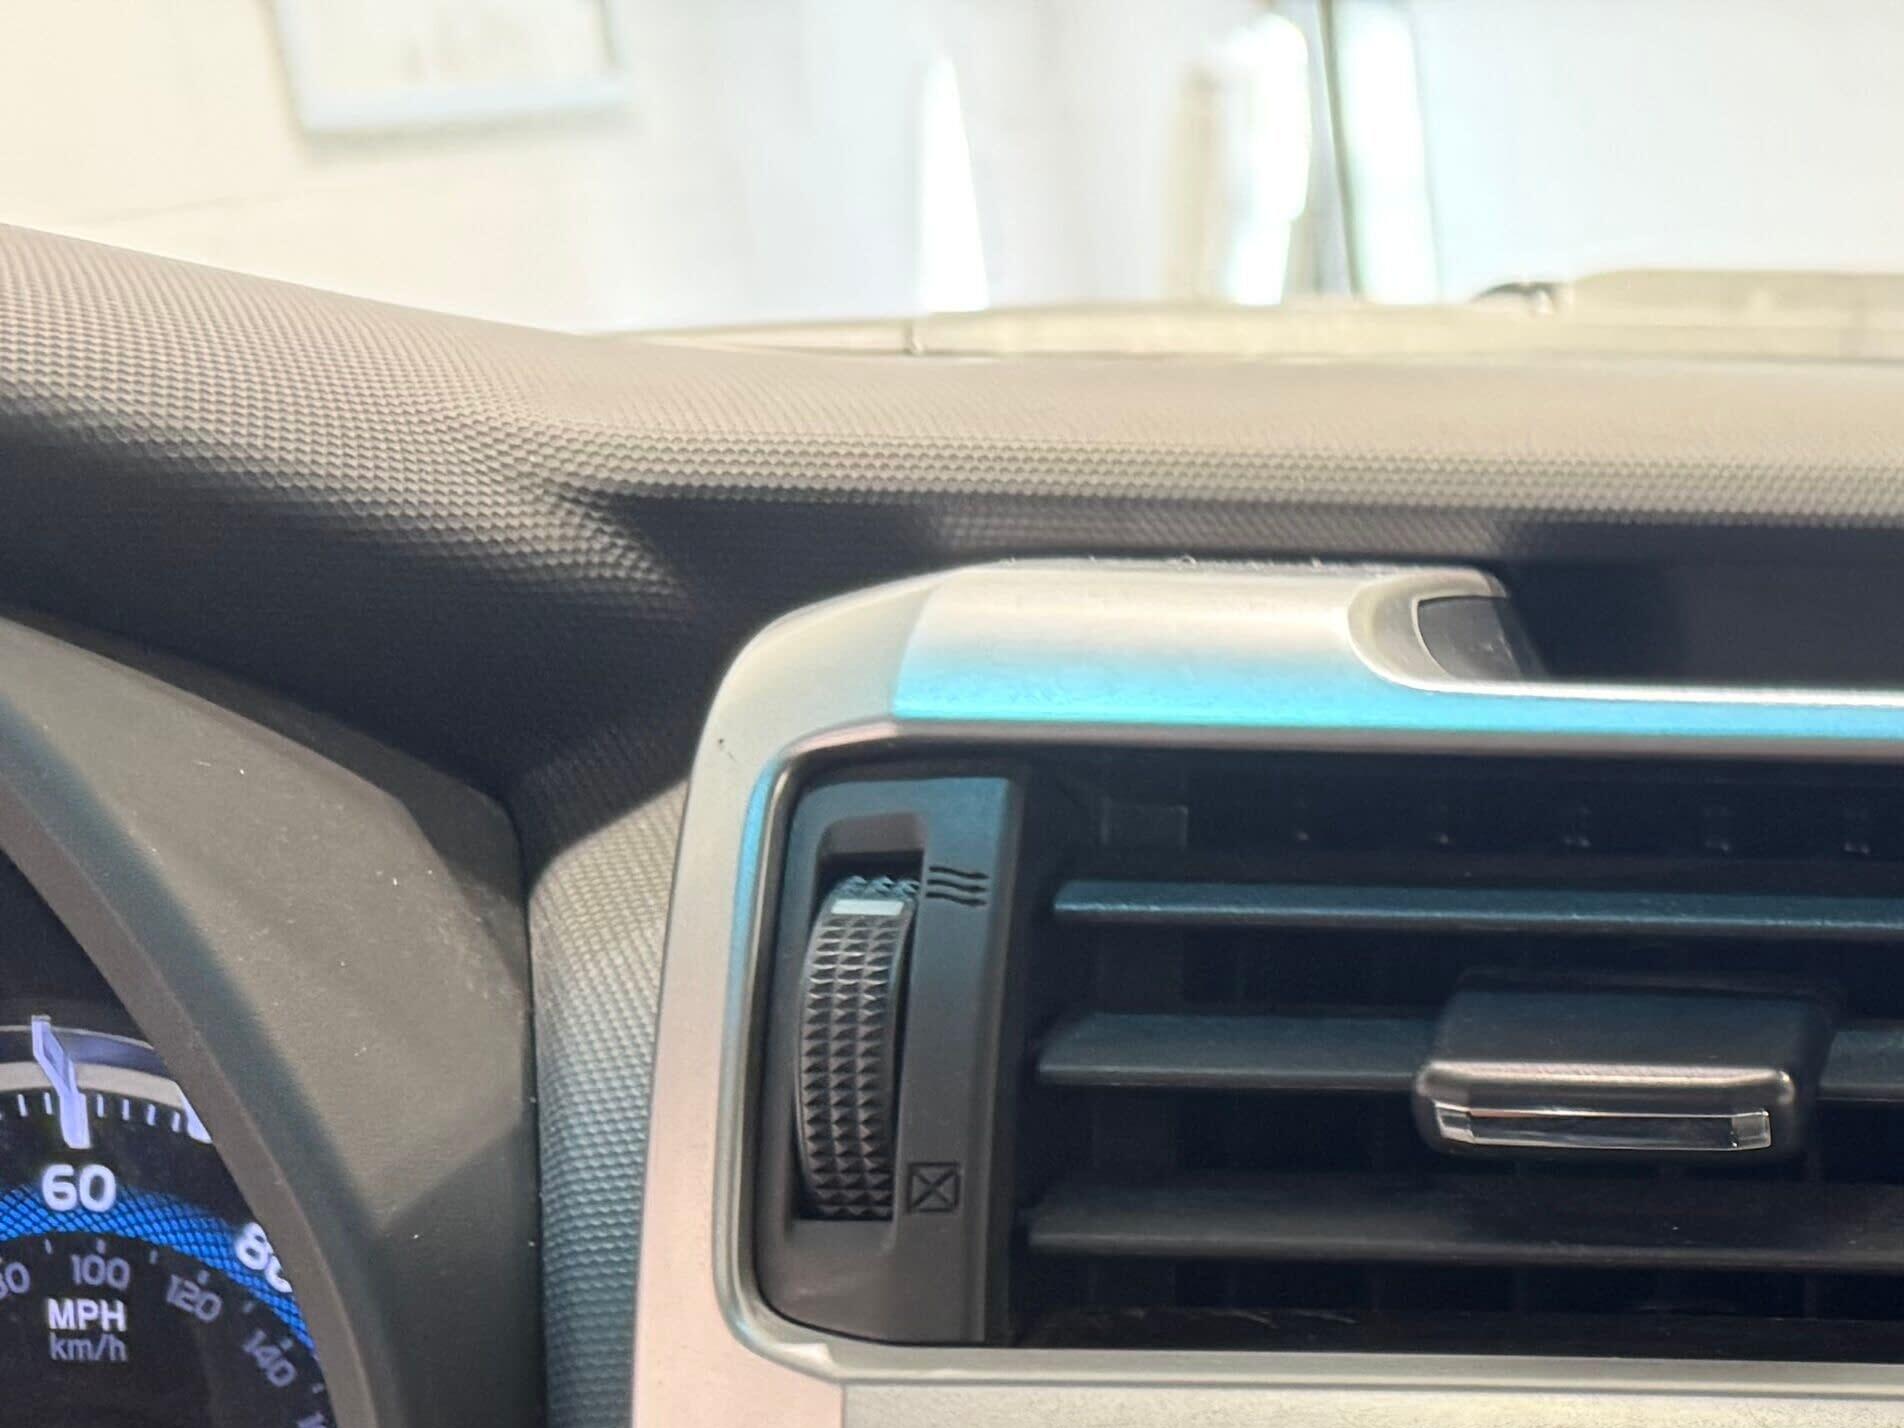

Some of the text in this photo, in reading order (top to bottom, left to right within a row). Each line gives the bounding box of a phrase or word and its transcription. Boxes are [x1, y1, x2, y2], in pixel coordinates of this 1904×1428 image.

[40, 1163, 117, 1213] 60
[70, 1252, 131, 1292] 100
[47, 1297, 128, 1332] MPH
[165, 1273, 223, 1323] 120
[49, 1333, 128, 1362] km/h
[241, 1330, 297, 1388] 140
